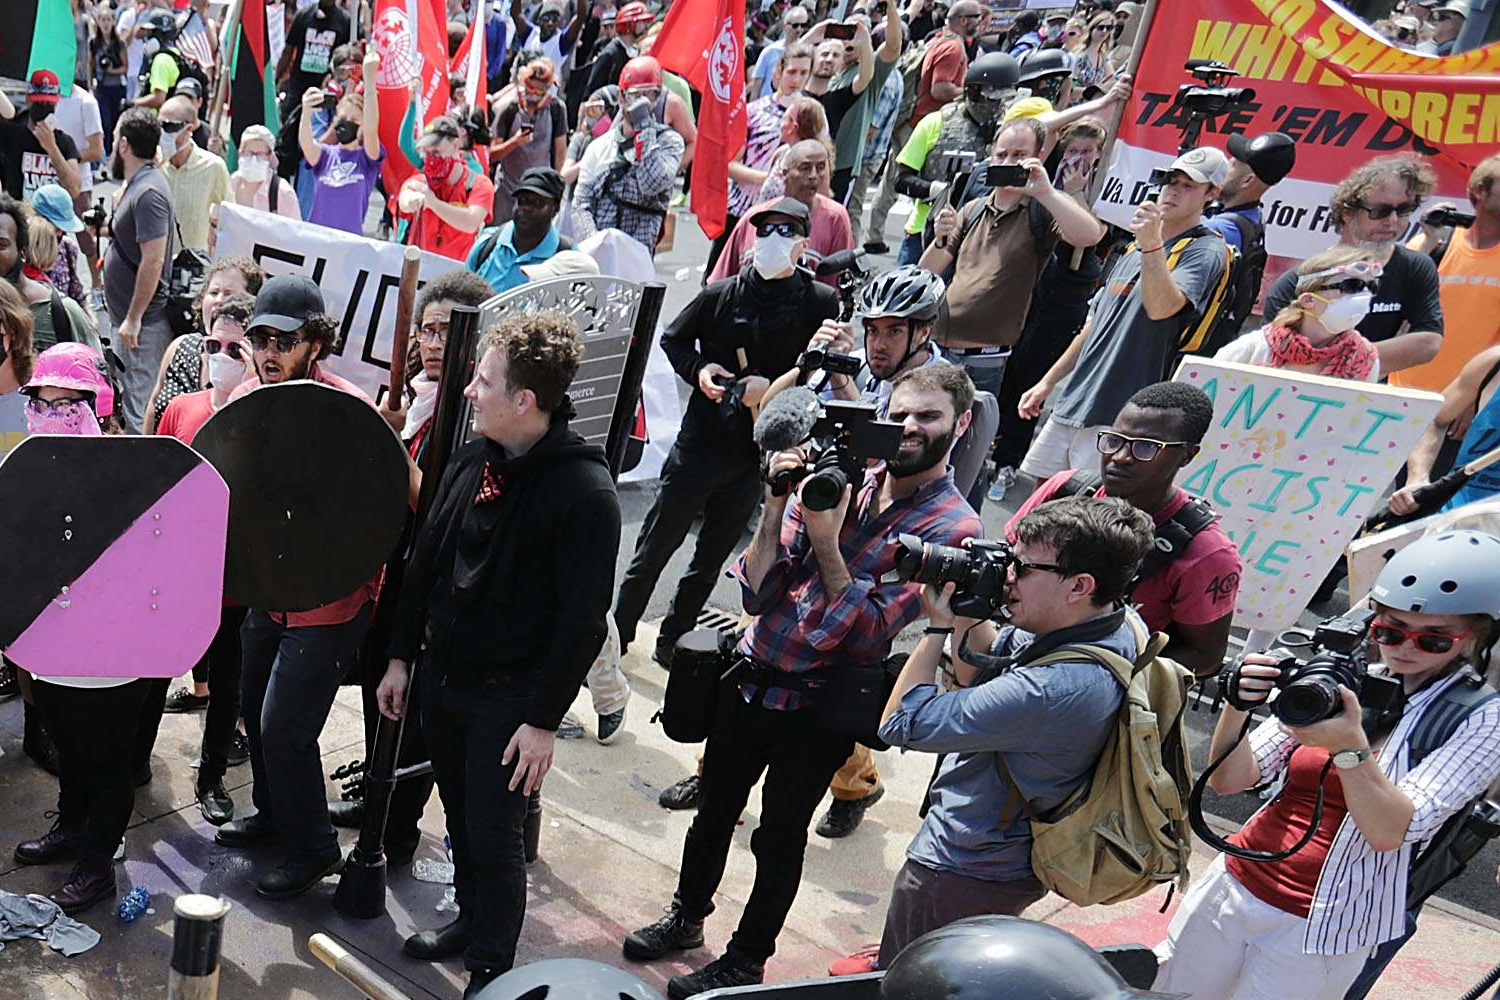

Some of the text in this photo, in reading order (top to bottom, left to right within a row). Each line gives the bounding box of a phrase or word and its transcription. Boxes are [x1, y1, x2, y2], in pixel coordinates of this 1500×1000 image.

[22, 153, 57, 175] BLAC
[1100, 176, 1124, 205] Va.
[1266, 200, 1307, 229] for
